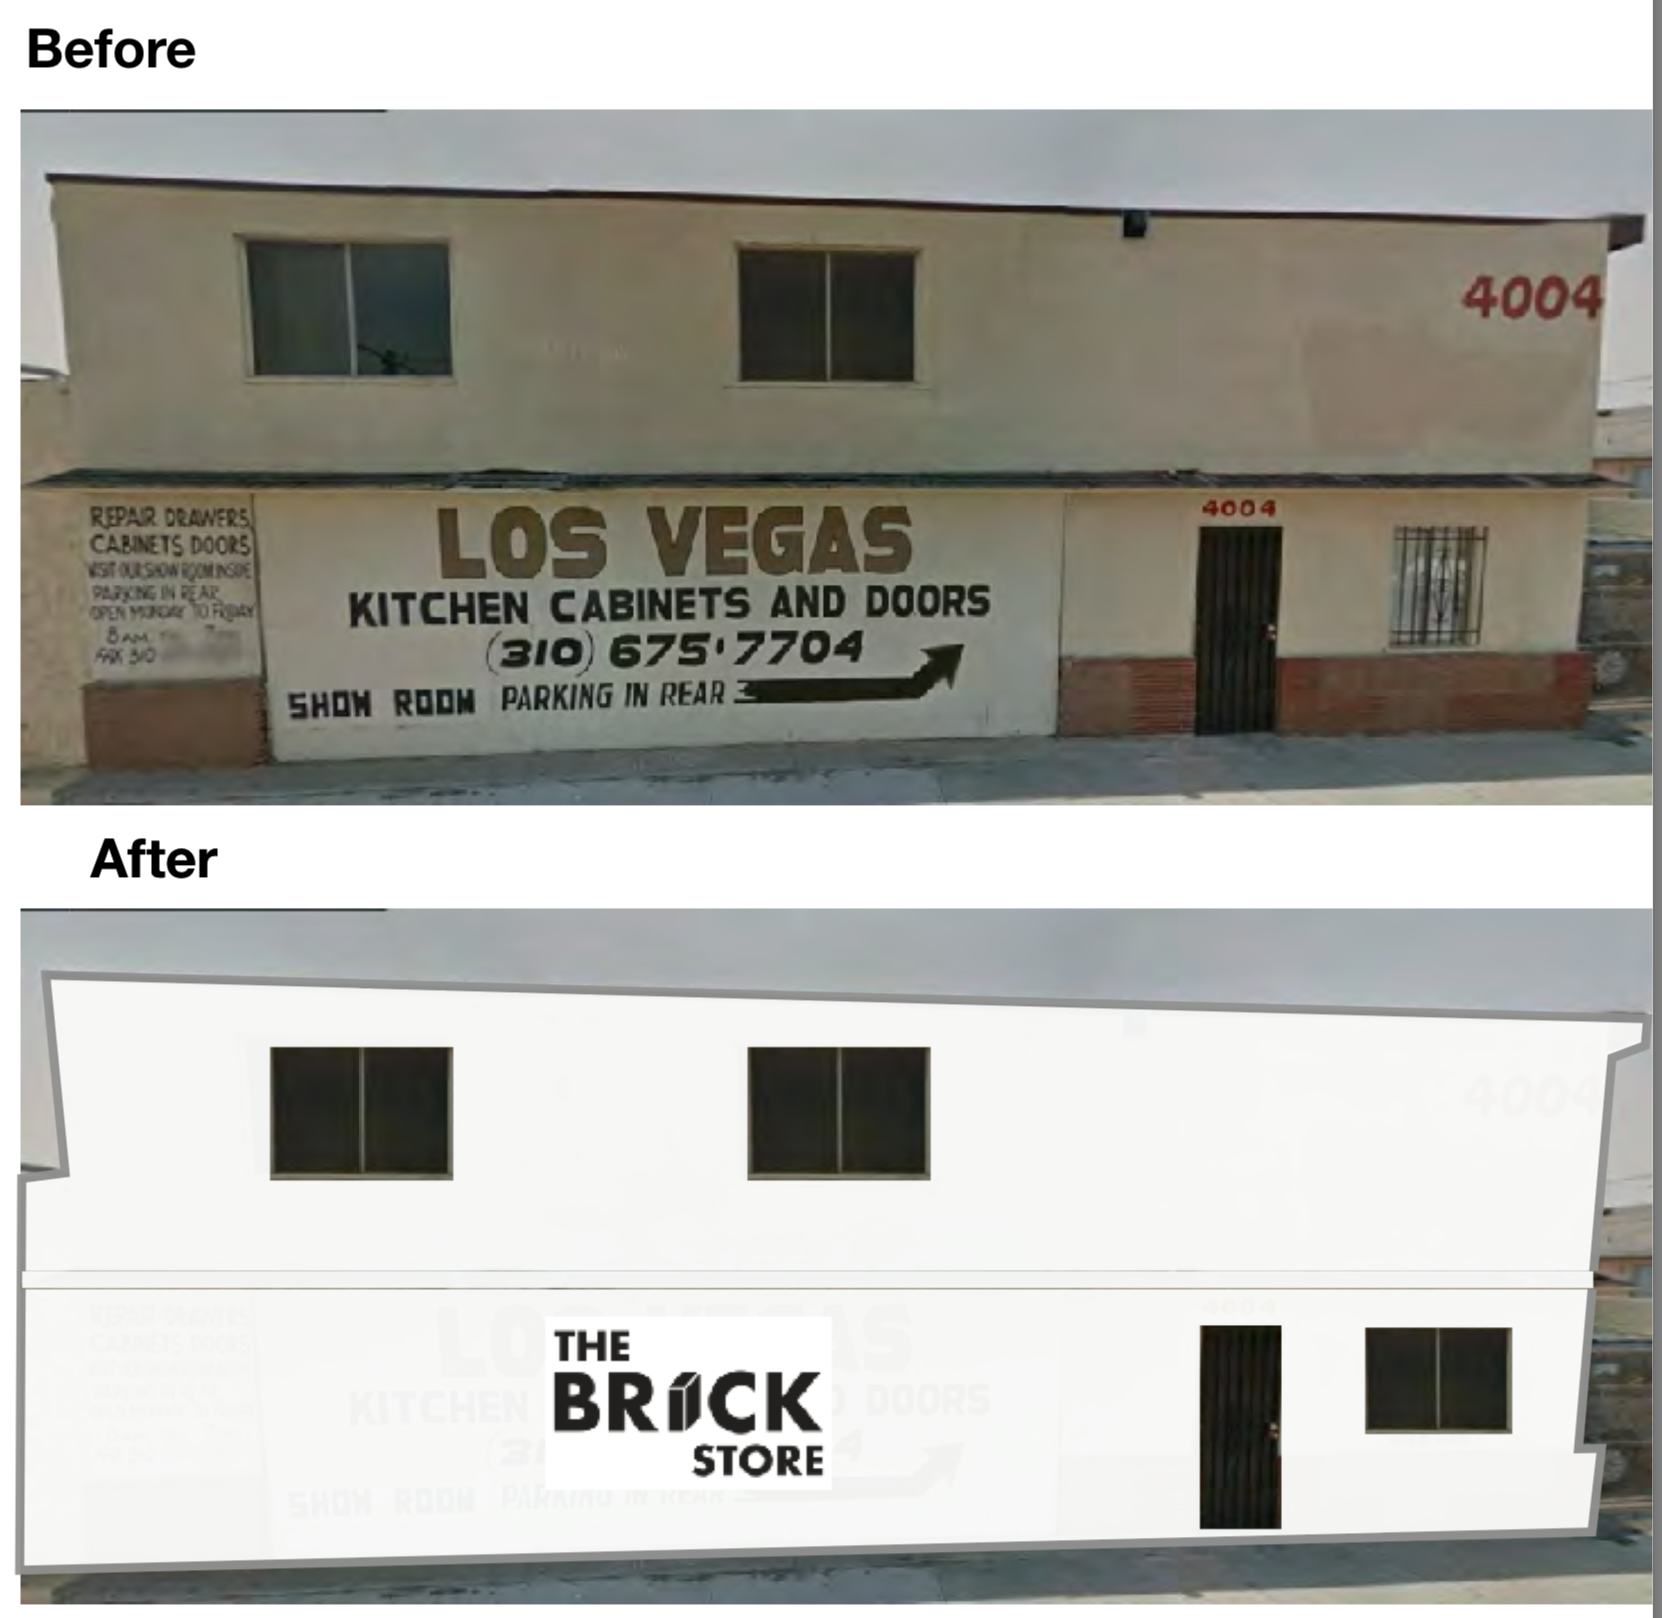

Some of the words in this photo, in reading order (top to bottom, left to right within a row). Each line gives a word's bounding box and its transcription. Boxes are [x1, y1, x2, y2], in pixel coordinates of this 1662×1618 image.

[1461, 274, 1604, 319] 4004
[89, 506, 157, 529] REPAIR
[164, 507, 251, 528] DRAWERS
[1201, 499, 1277, 517] 4004
[89, 533, 184, 557] CABINETS
[190, 534, 251, 556] DOORS
[437, 505, 608, 580] LOS
[646, 505, 913, 577] VEGAS
[92, 585, 157, 603] PARKING
[160, 586, 176, 600] IN
[349, 592, 529, 627] KITCHEN
[549, 587, 751, 623] CABINETS
[770, 586, 847, 618] AND
[865, 585, 992, 618] DOORS
[485, 629, 596, 678] (310)
[287, 689, 372, 721] SHOW
[393, 688, 476, 717] ROOM
[501, 682, 614, 712] PARKING
[624, 682, 649, 708] IN
[659, 680, 726, 706] REAR
[554, 1330, 630, 1362] THE
[554, 1370, 823, 1435] BRICK
[691, 1443, 823, 1478] STORE
